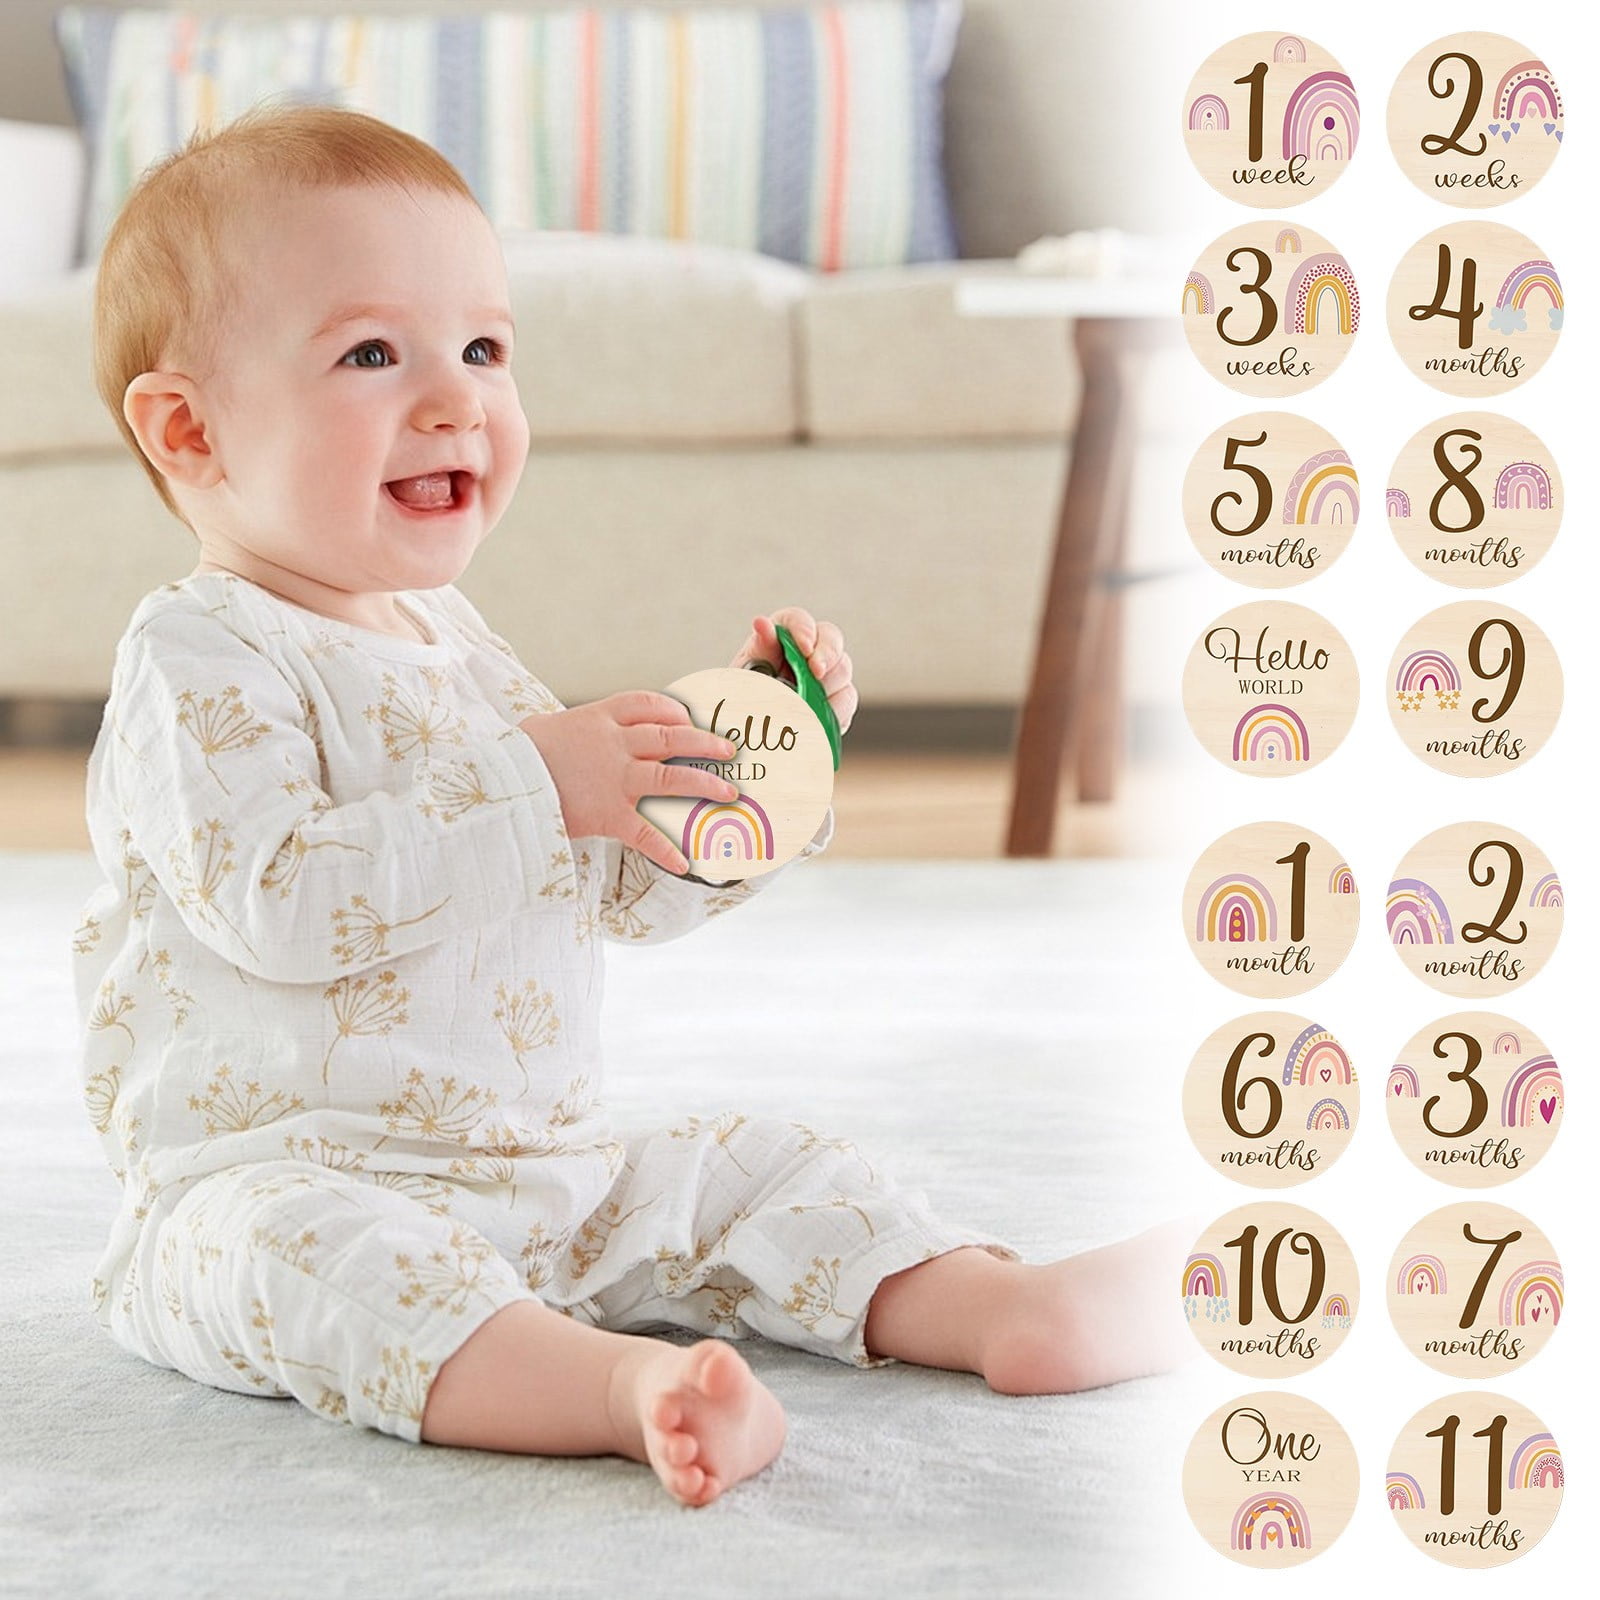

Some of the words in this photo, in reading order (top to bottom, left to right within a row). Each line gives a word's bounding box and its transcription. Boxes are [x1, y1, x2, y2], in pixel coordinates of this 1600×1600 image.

[1233, 61, 1269, 163] 1
[1420, 52, 1488, 157] 2
[1232, 154, 1316, 186] week
[1434, 159, 1523, 189] weeks
[1216, 247, 1279, 347] 3
[1408, 243, 1484, 350] 4
[1226, 347, 1316, 378] weeks
[1424, 346, 1525, 378] months
[1210, 430, 1273, 537] 5
[1429, 428, 1485, 534] 8
[1221, 537, 1321, 568] months
[1424, 537, 1525, 568] months
[1204, 625, 1330, 674] Hello
[1468, 618, 1526, 724] 9
[1238, 679, 1303, 695] WORLD
[684, 699, 799, 751] ello
[1426, 730, 1527, 761] months
[1275, 841, 1311, 943] 1
[1461, 840, 1528, 945] 2
[1226, 945, 1316, 977] month
[1424, 950, 1525, 981] months
[1221, 1032, 1283, 1139] 6
[1422, 1031, 1489, 1139] 3
[1221, 1140, 1321, 1171] months
[1424, 1138, 1525, 1169] months
[1223, 1225, 1326, 1326] 10
[1458, 1222, 1522, 1330] 7
[1221, 1328, 1321, 1360] months
[1424, 1328, 1525, 1360] months
[1221, 1407, 1321, 1466] One
[1241, 1470, 1302, 1482] YEAR
[1425, 1414, 1508, 1516] 11
[1424, 1520, 1525, 1551] months
